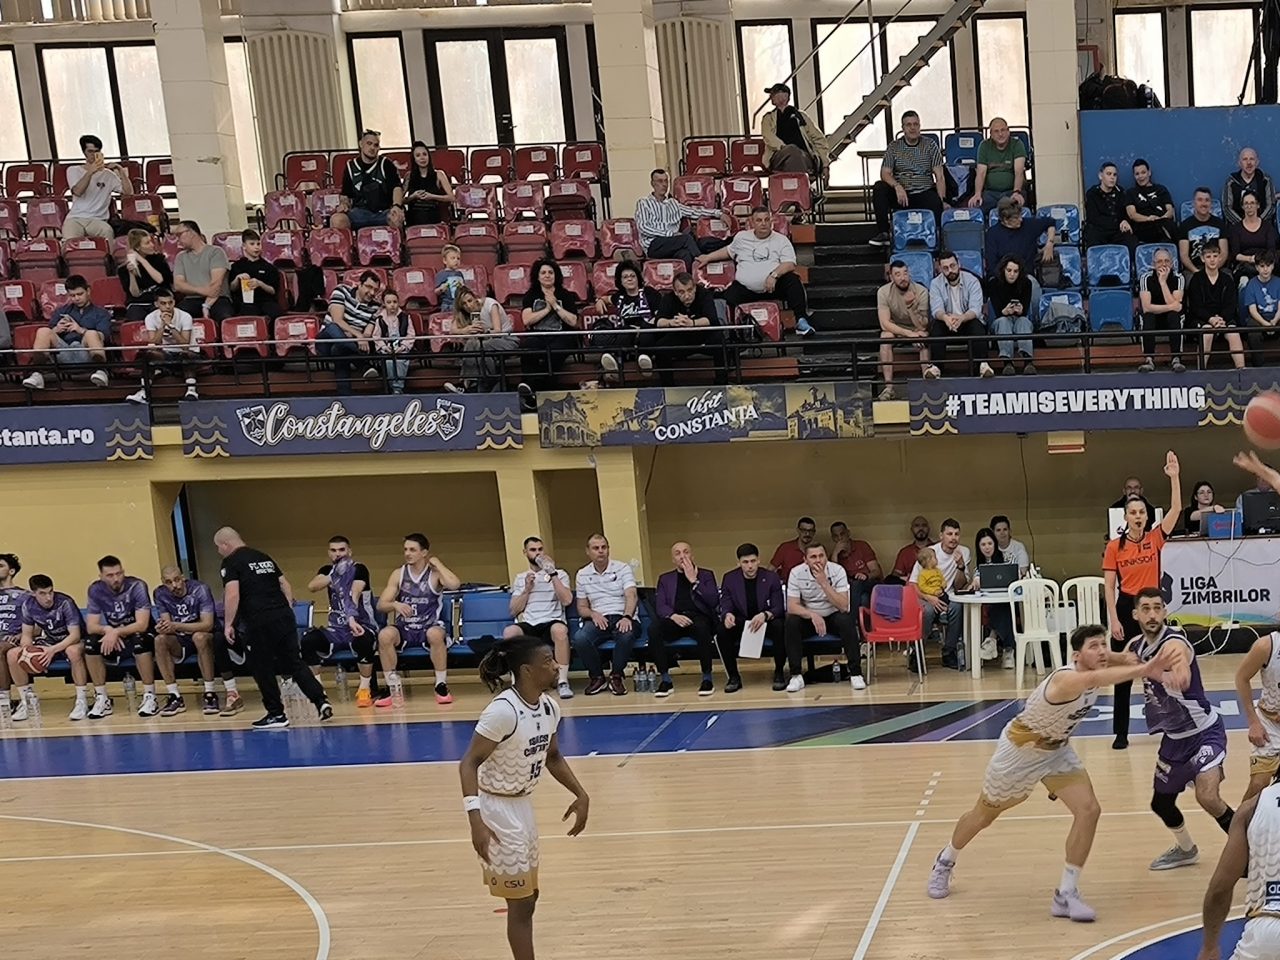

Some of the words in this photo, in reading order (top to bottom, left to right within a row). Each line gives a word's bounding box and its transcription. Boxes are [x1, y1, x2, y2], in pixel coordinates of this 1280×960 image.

[687, 390, 723, 414] Visit
[945, 386, 1206, 419] #TEAMISEVERYTHING
[265, 399, 441, 450] Constangeles
[0, 427, 96, 447] tanta.ro
[1180, 576, 1218, 591] LIGA
[1181, 588, 1271, 606] ZIMBRILOR
[177, 604, 189, 616] 22
[503, 879, 526, 889] CSU
